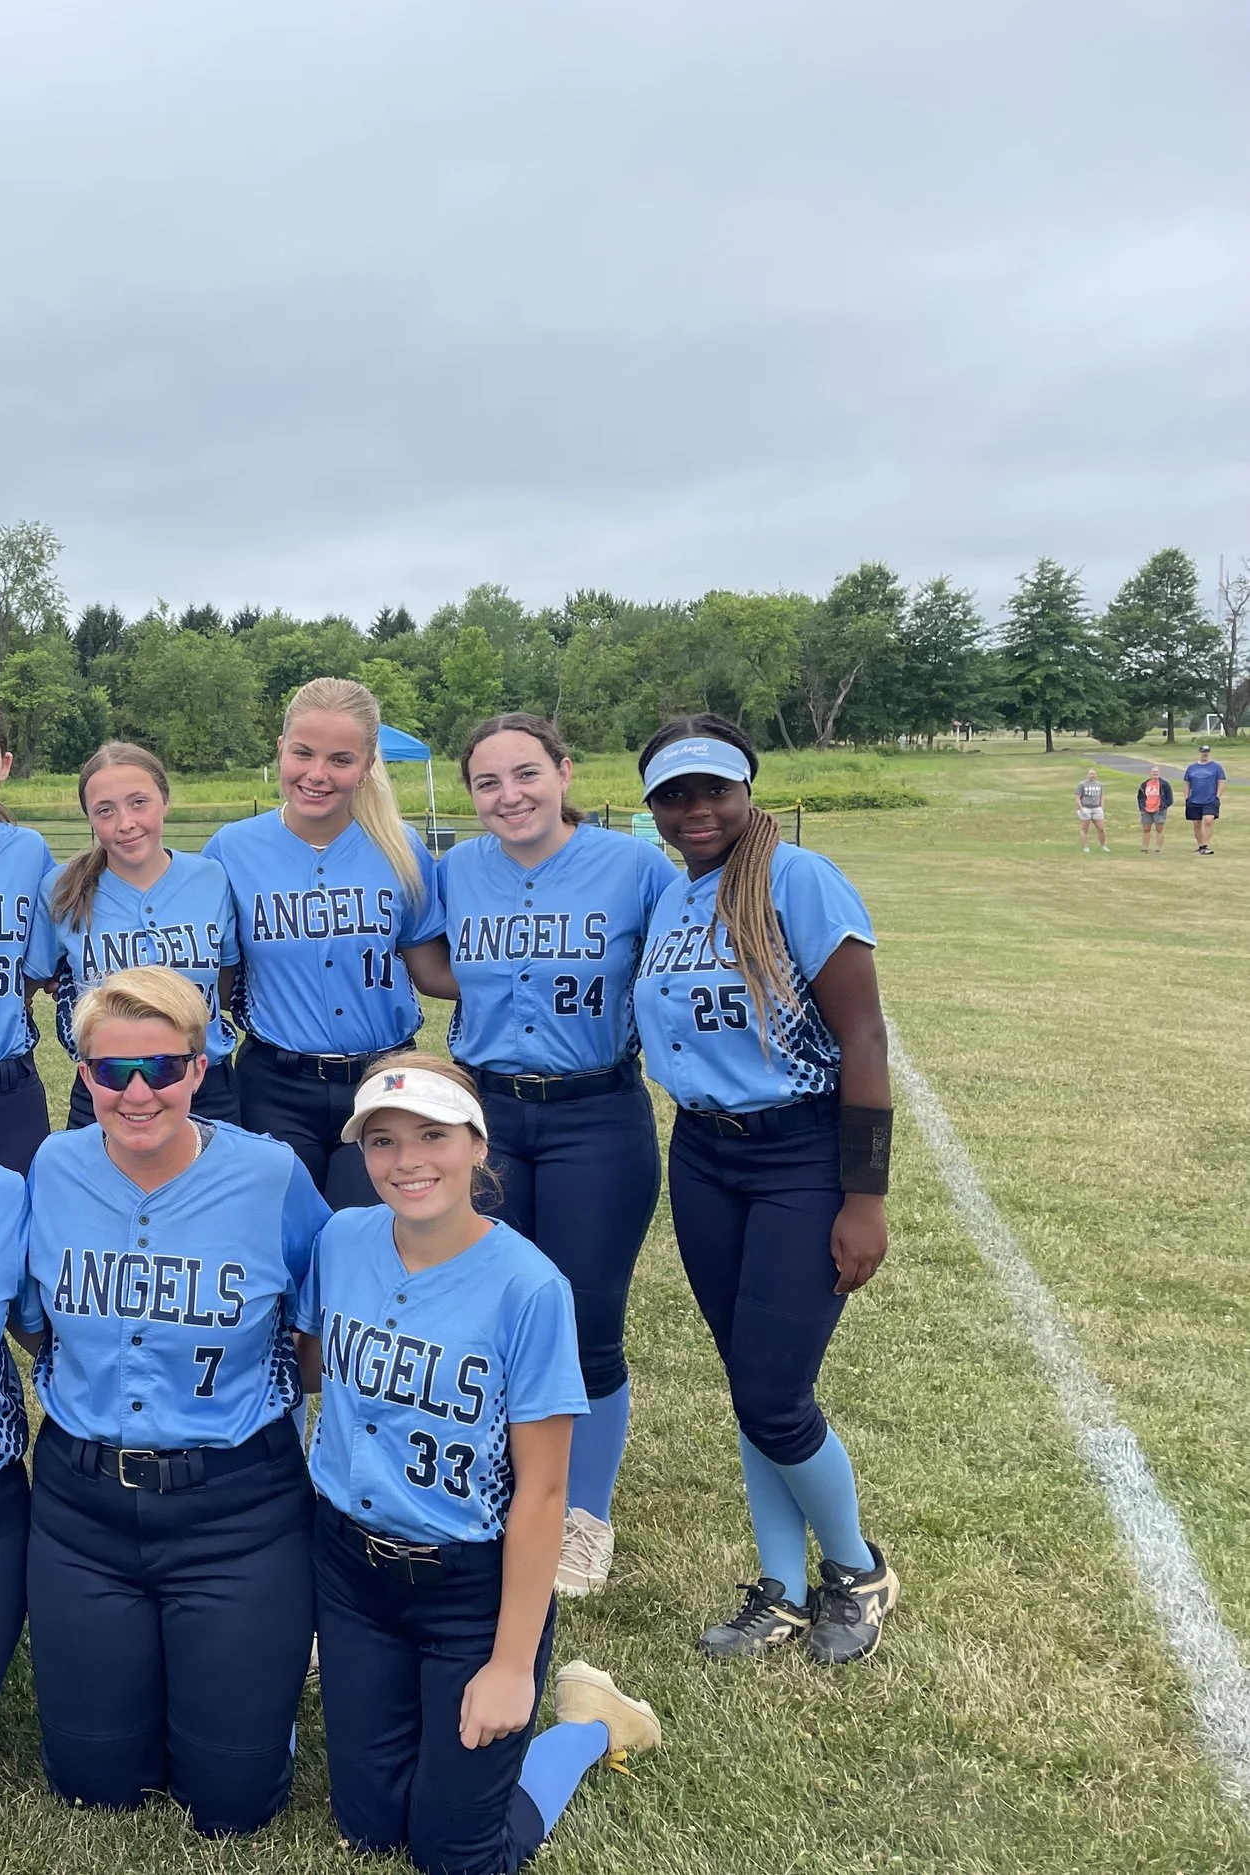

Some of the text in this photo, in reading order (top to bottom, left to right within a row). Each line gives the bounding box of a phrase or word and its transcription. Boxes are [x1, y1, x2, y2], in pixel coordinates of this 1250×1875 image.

[680, 744, 710, 756] Angels
[252, 887, 394, 942] ANGELS
[454, 912, 608, 964] ANGELS
[81, 922, 220, 982] ANGELS
[361, 946, 395, 991] 11
[636, 924, 740, 980] NGEL
[553, 975, 605, 1018] 24
[690, 984, 748, 1033] 25
[383, 1073, 406, 1092] N
[53, 1247, 247, 1328] ANGELS
[193, 1346, 226, 1398] 7
[405, 1430, 476, 1499] 33
